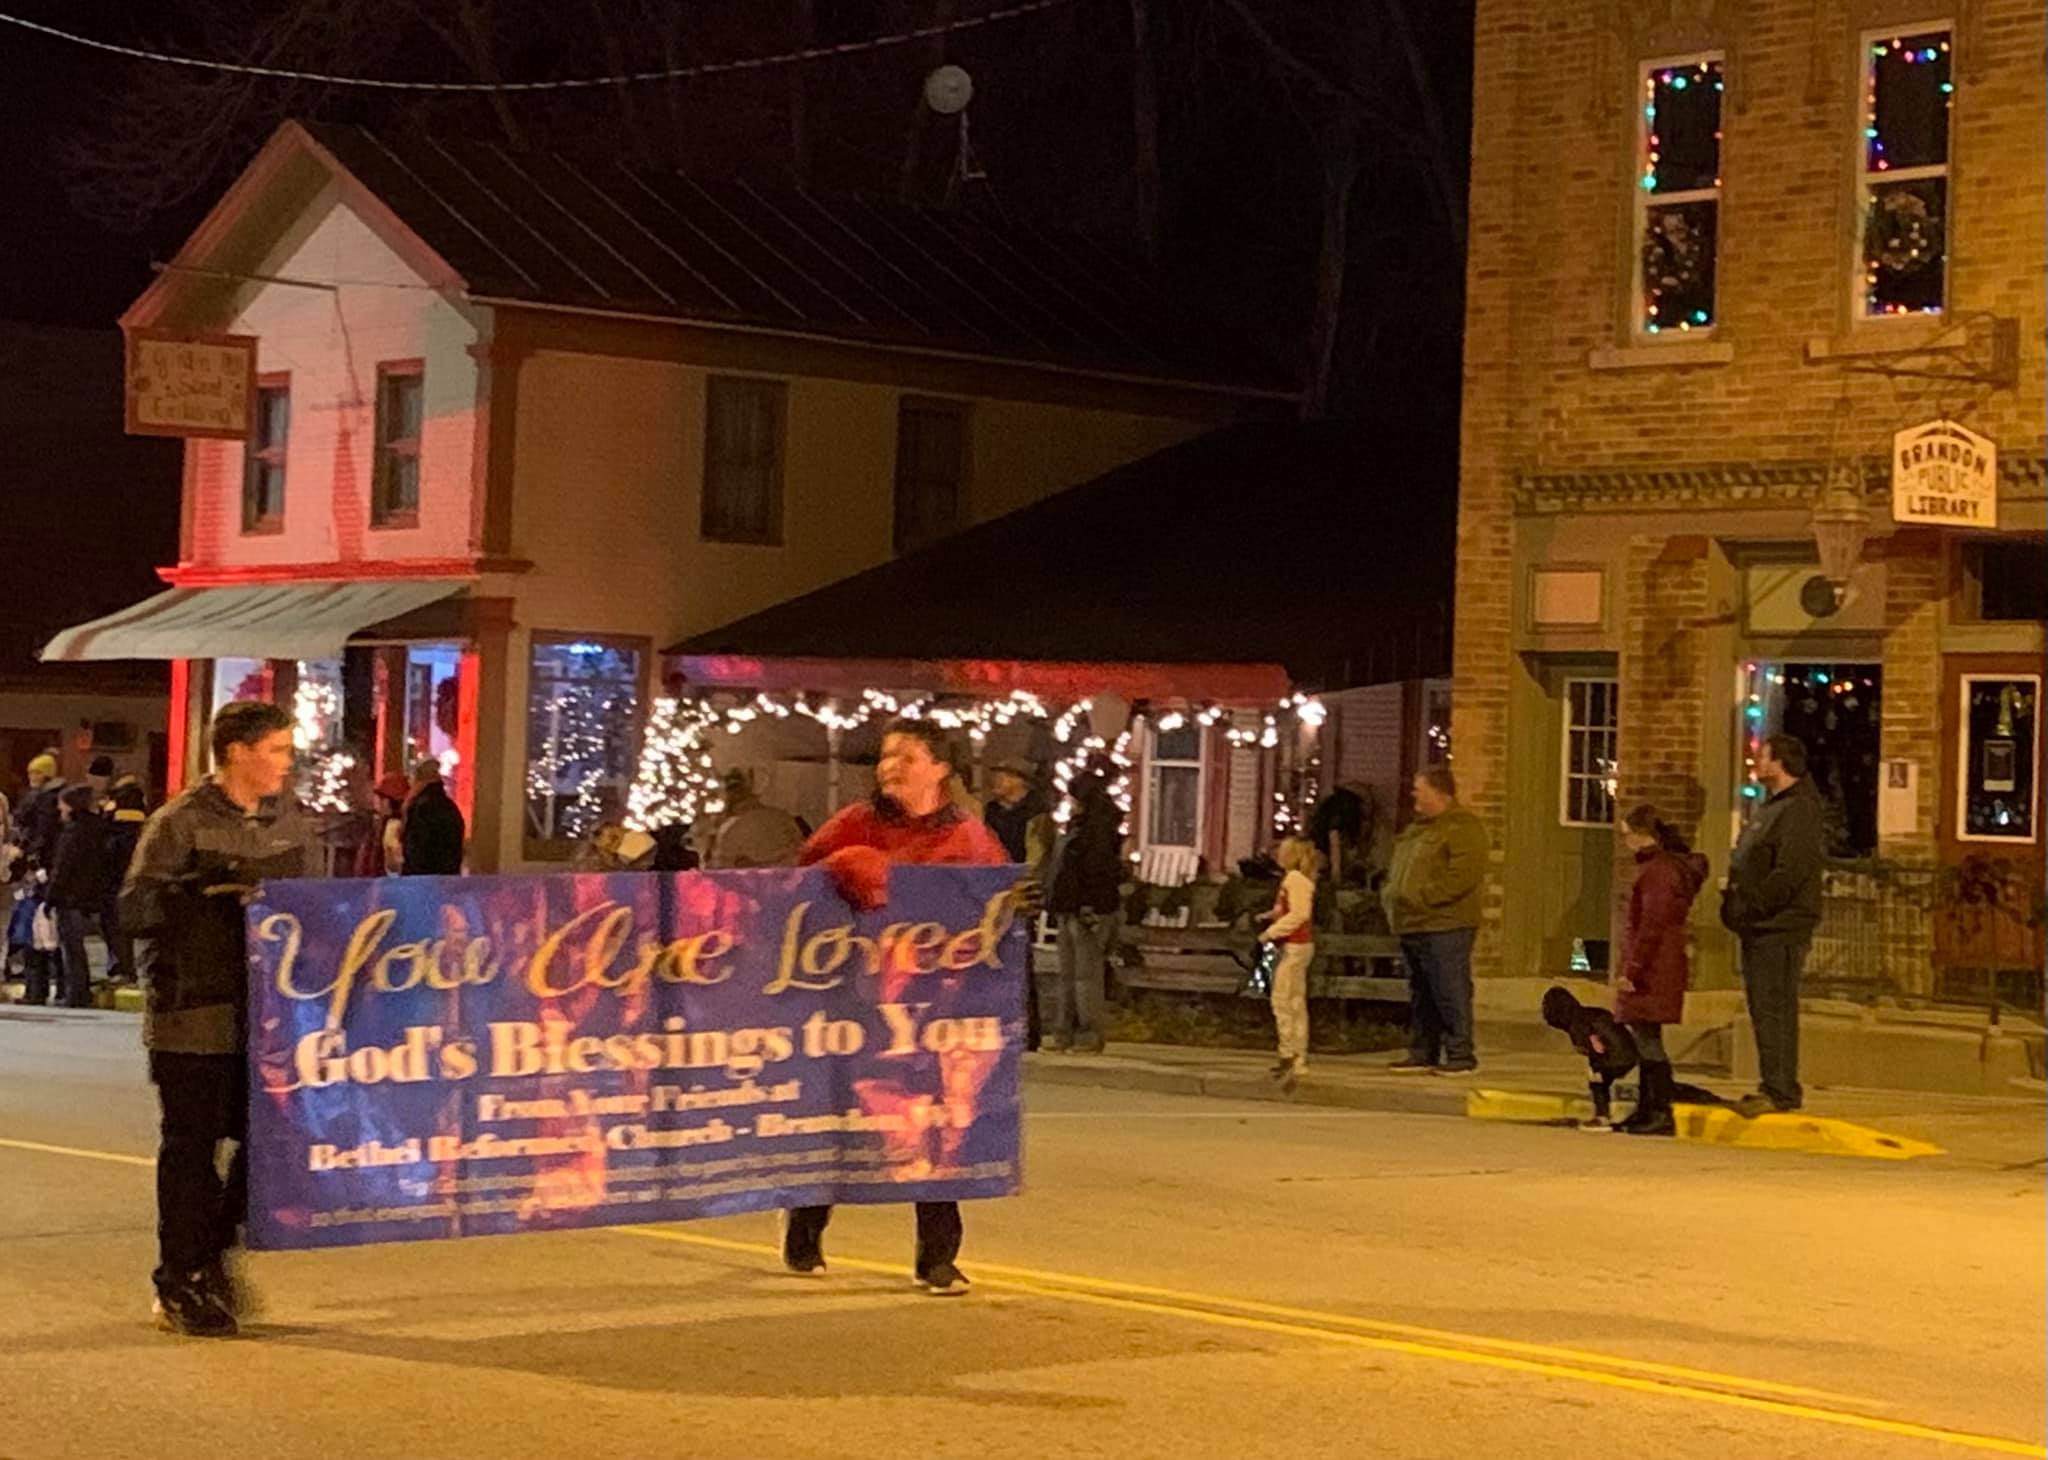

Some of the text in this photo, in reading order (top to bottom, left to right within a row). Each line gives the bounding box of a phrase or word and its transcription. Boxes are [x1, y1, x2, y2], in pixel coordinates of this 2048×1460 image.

[1900, 441, 1987, 477] BRANDON
[1917, 464, 1970, 494] PUBLIC
[1907, 495, 1979, 518] LIBRARY
[259, 889, 1016, 1035] You Are Loved
[295, 1002, 1008, 1087] God's Blessings to You
[309, 1138, 421, 1171] Bethel
[606, 1117, 734, 1149] Church
